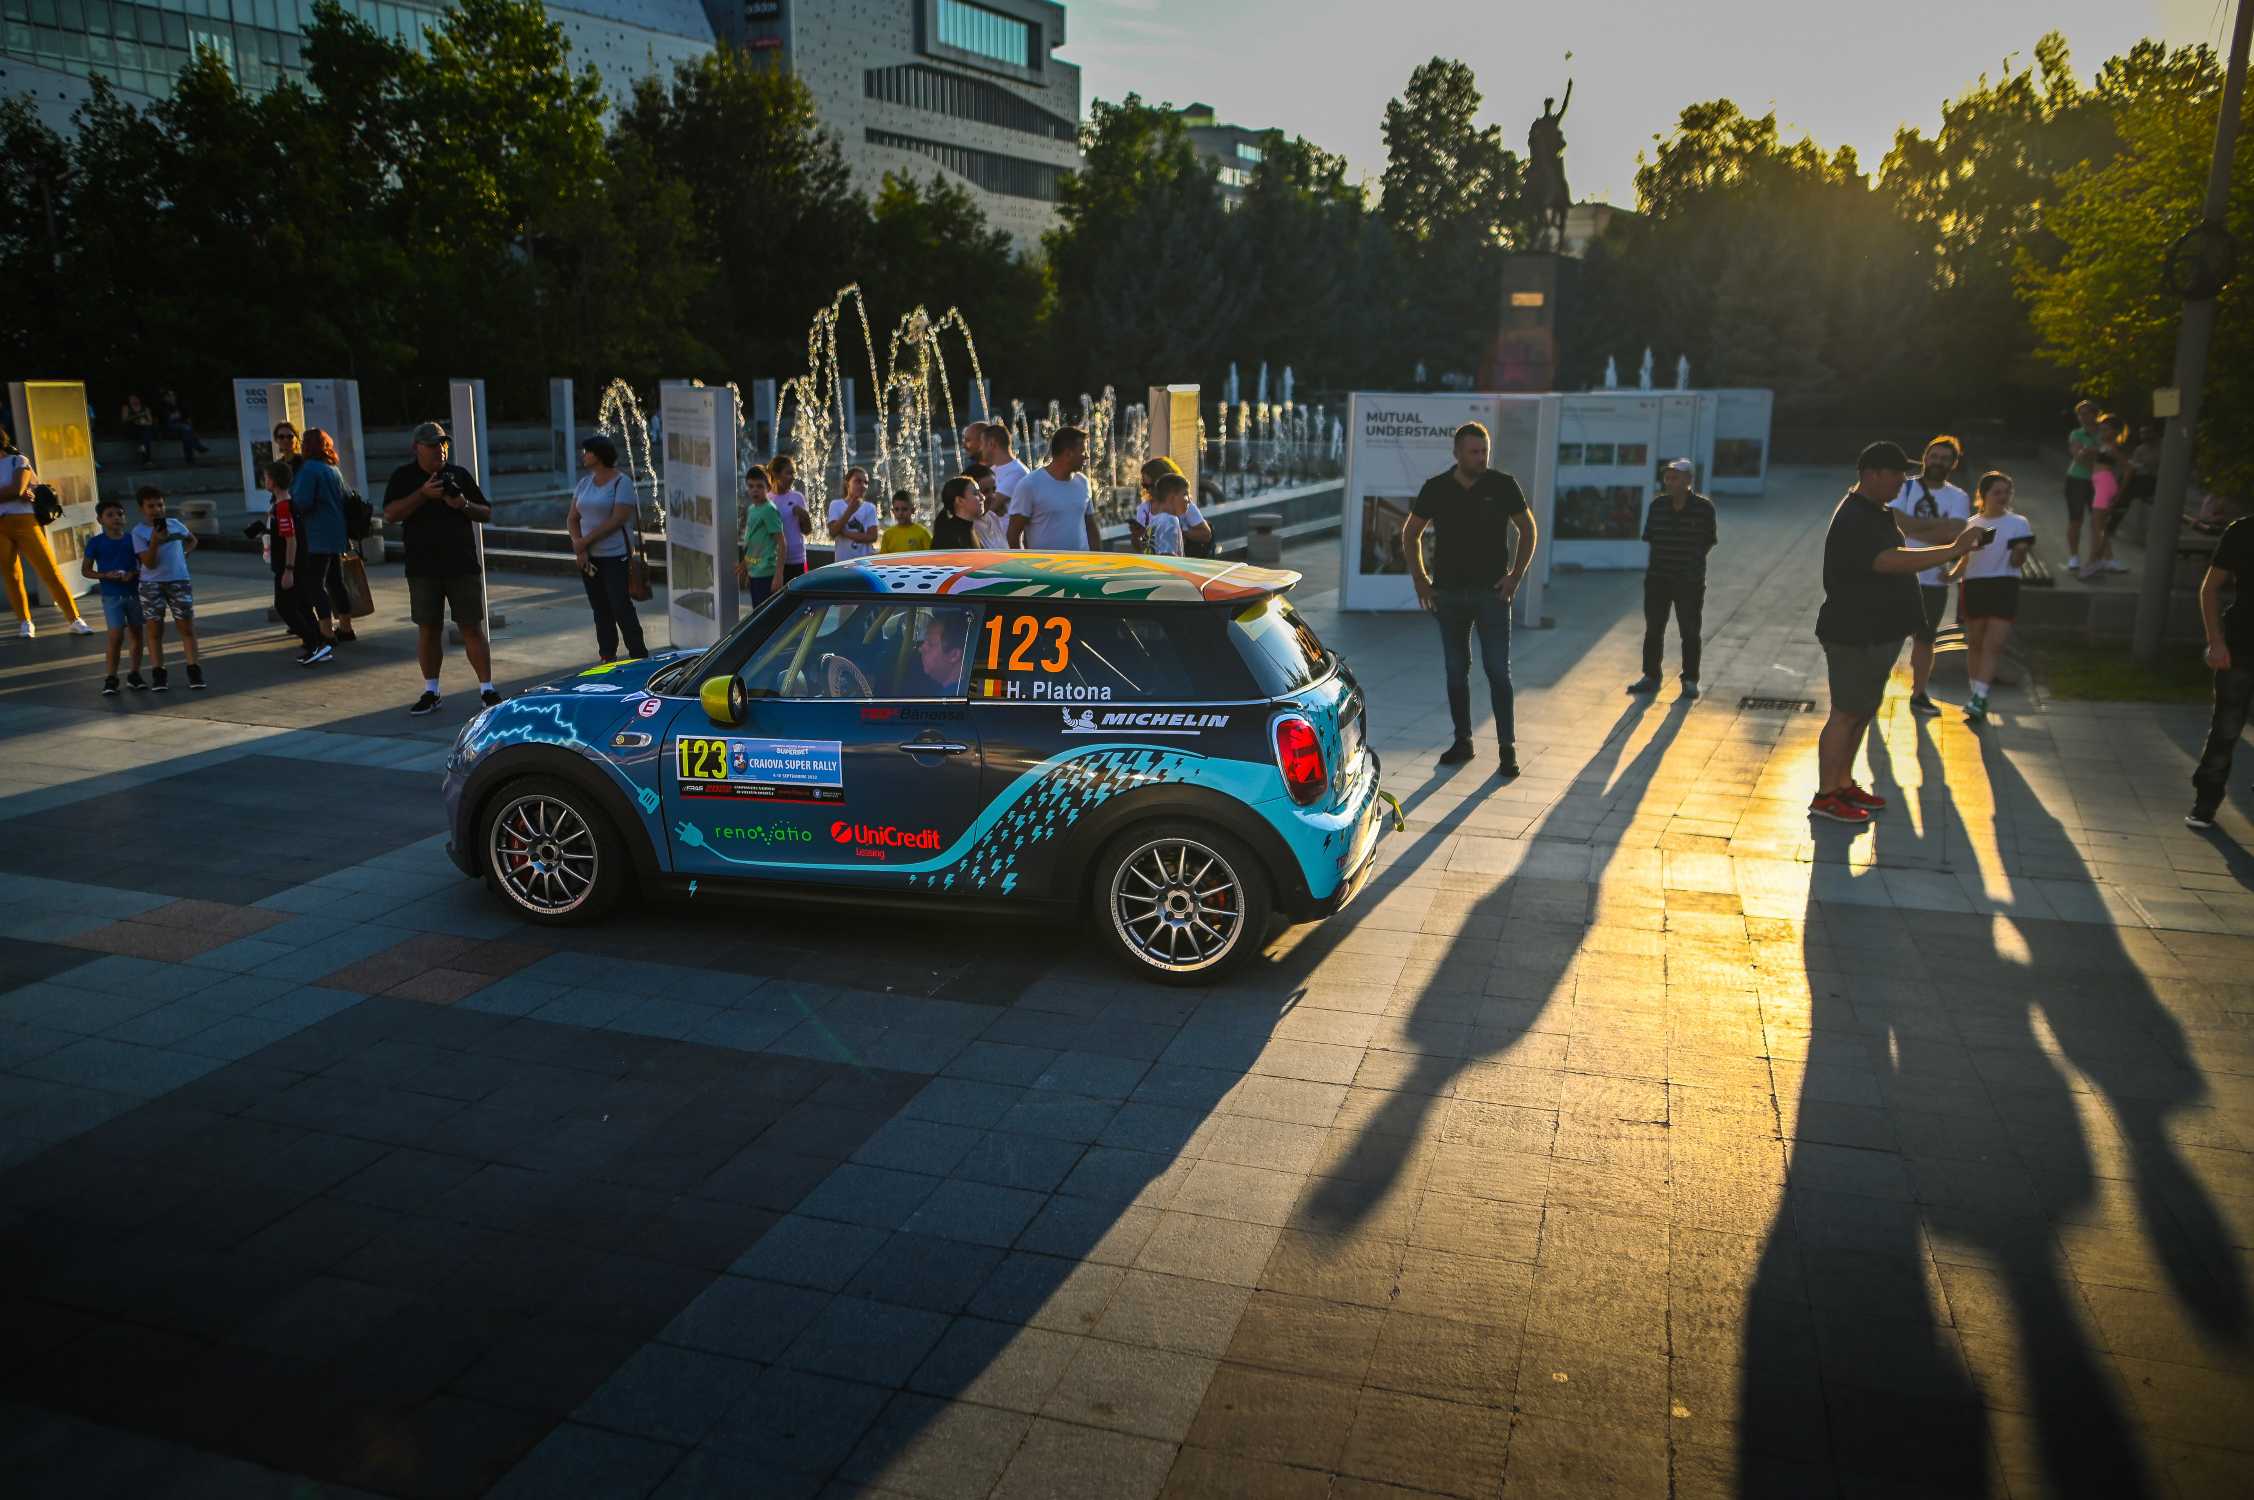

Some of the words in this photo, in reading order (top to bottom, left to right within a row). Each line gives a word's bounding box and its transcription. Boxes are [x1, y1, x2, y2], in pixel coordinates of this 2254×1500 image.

[1366, 412, 1423, 423] MUTUAL
[1366, 425, 1456, 437] UNDERSTAND
[985, 615, 1072, 673] 123
[1007, 681, 1027, 699] H.
[1033, 681, 1111, 700] Platona
[1101, 713, 1230, 728] MICHELIN
[679, 739, 728, 778] 123
[749, 758, 783, 769] CRAIOVA
[785, 759, 811, 770] SUPER
[812, 760, 837, 771] RALLY
[854, 824, 940, 849] UniCredit
